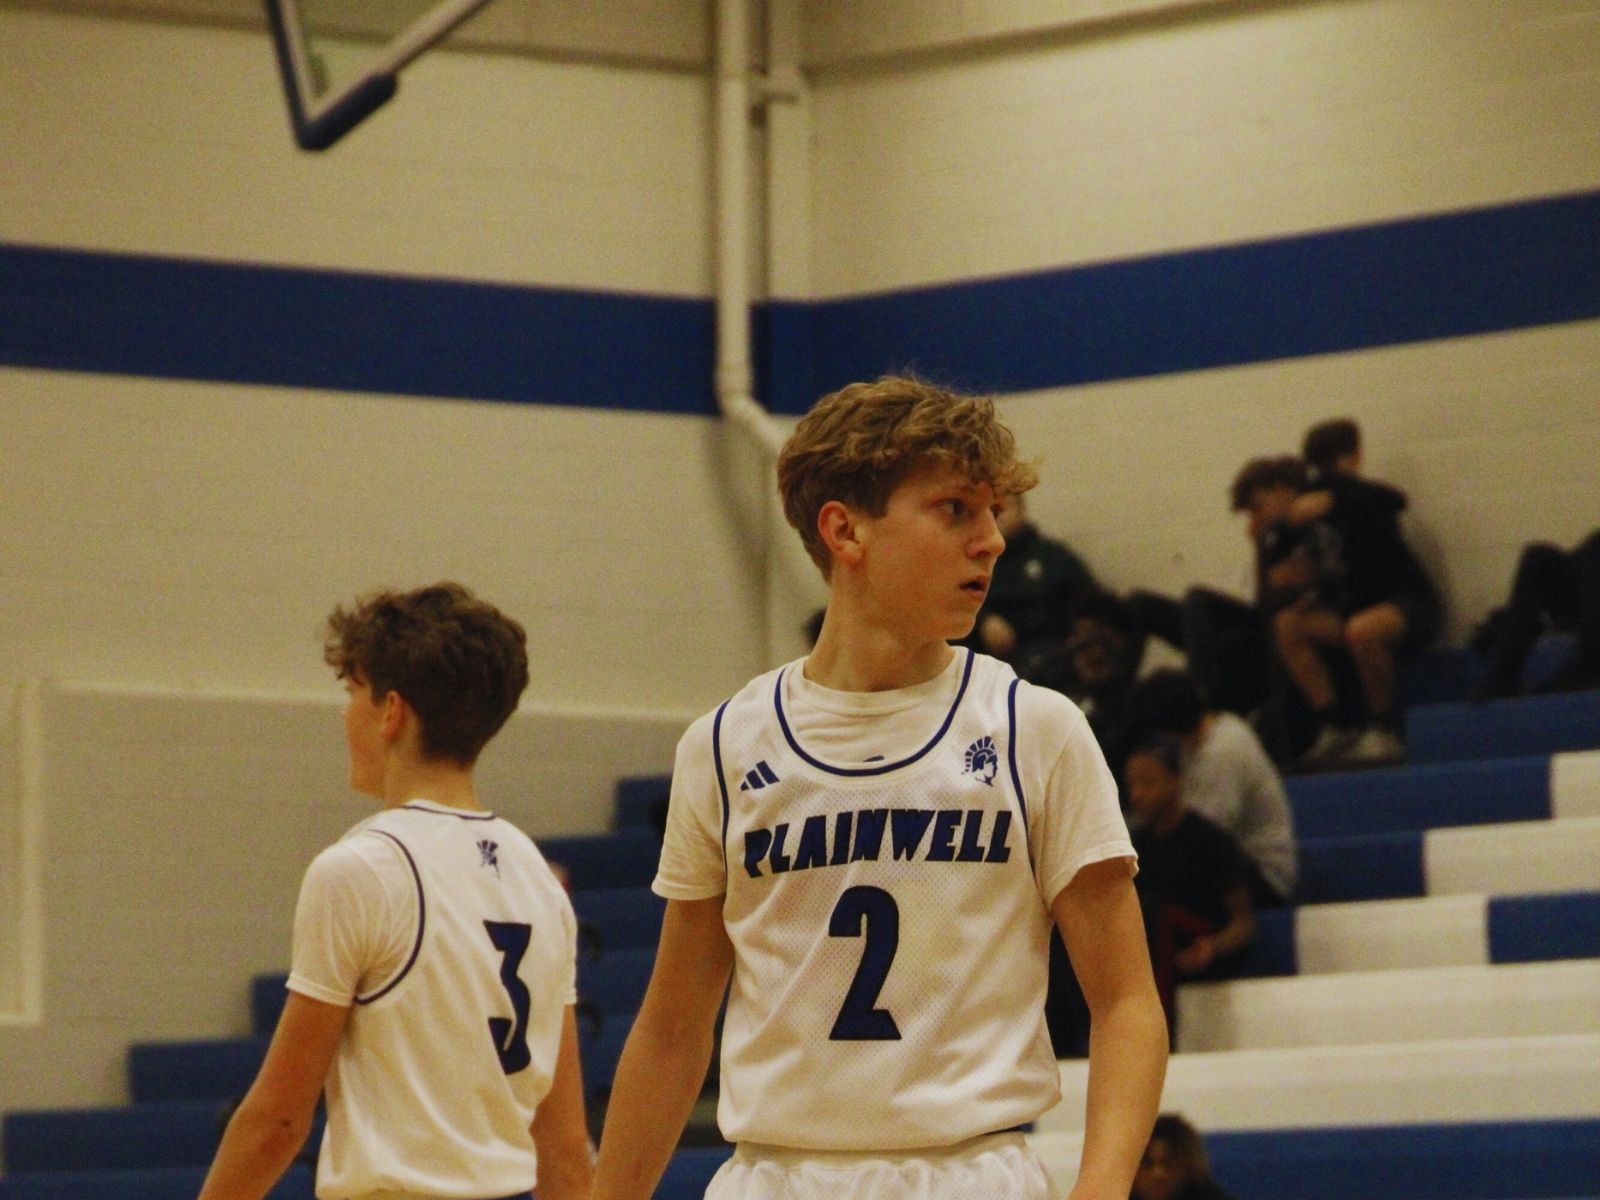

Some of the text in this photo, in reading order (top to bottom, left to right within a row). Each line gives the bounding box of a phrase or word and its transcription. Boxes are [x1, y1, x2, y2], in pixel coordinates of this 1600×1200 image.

[744, 808, 1012, 878] PLAINWELL
[483, 919, 532, 1075] 3
[829, 885, 902, 1041] 2
